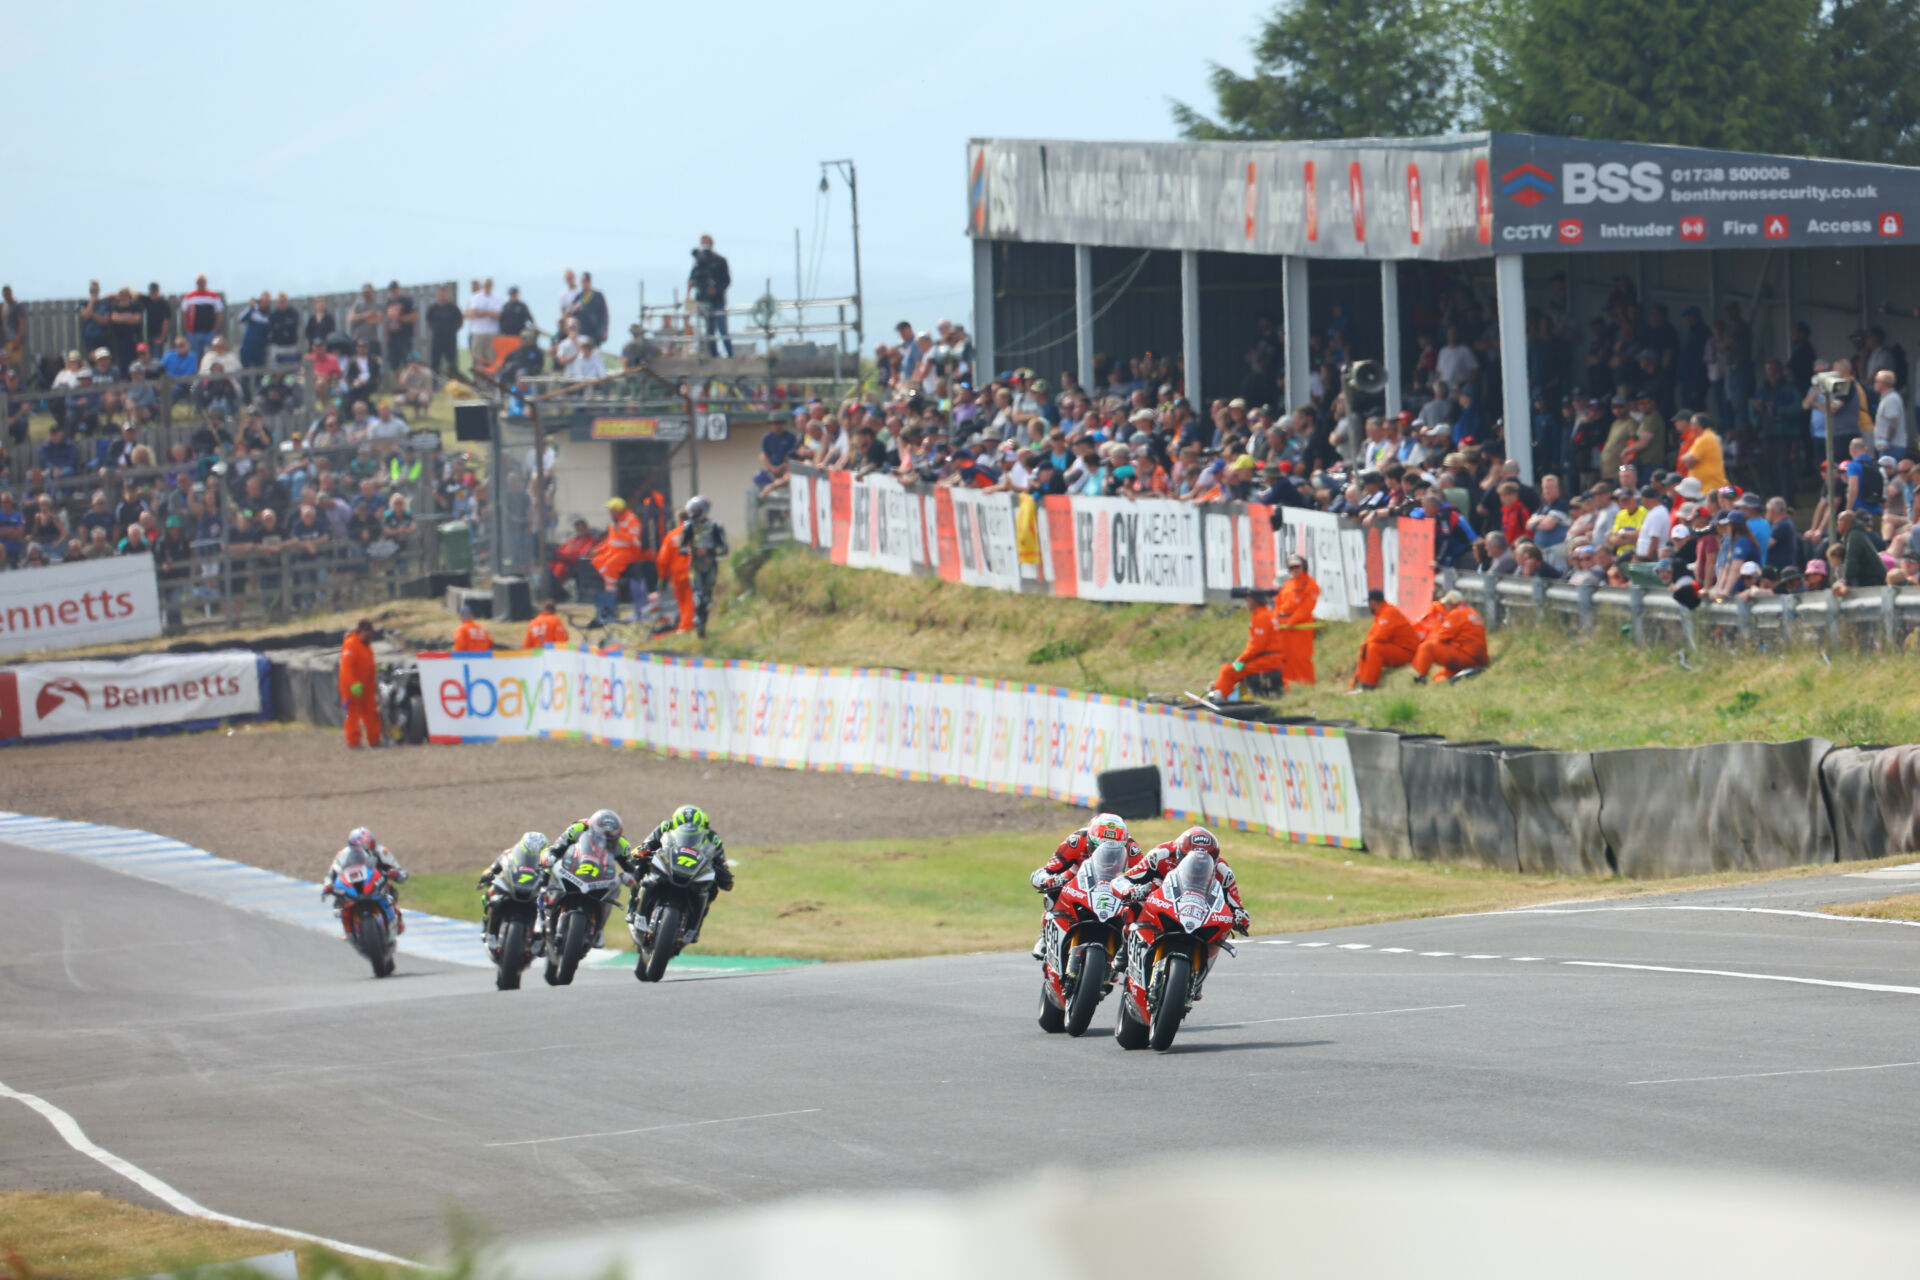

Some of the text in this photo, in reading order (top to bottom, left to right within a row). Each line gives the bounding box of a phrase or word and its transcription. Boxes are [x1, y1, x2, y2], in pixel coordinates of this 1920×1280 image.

[1562, 161, 1664, 204] BSS
[1671, 167, 1790, 182] 01738 500006
[1671, 185, 1878, 203] bonthronesecurity.co.uk
[1502, 219, 1872, 240] CCTV Intruder Fire Access
[0, 589, 135, 635] nnetts
[103, 674, 240, 709] Bennetts
[439, 663, 542, 731] ebay
